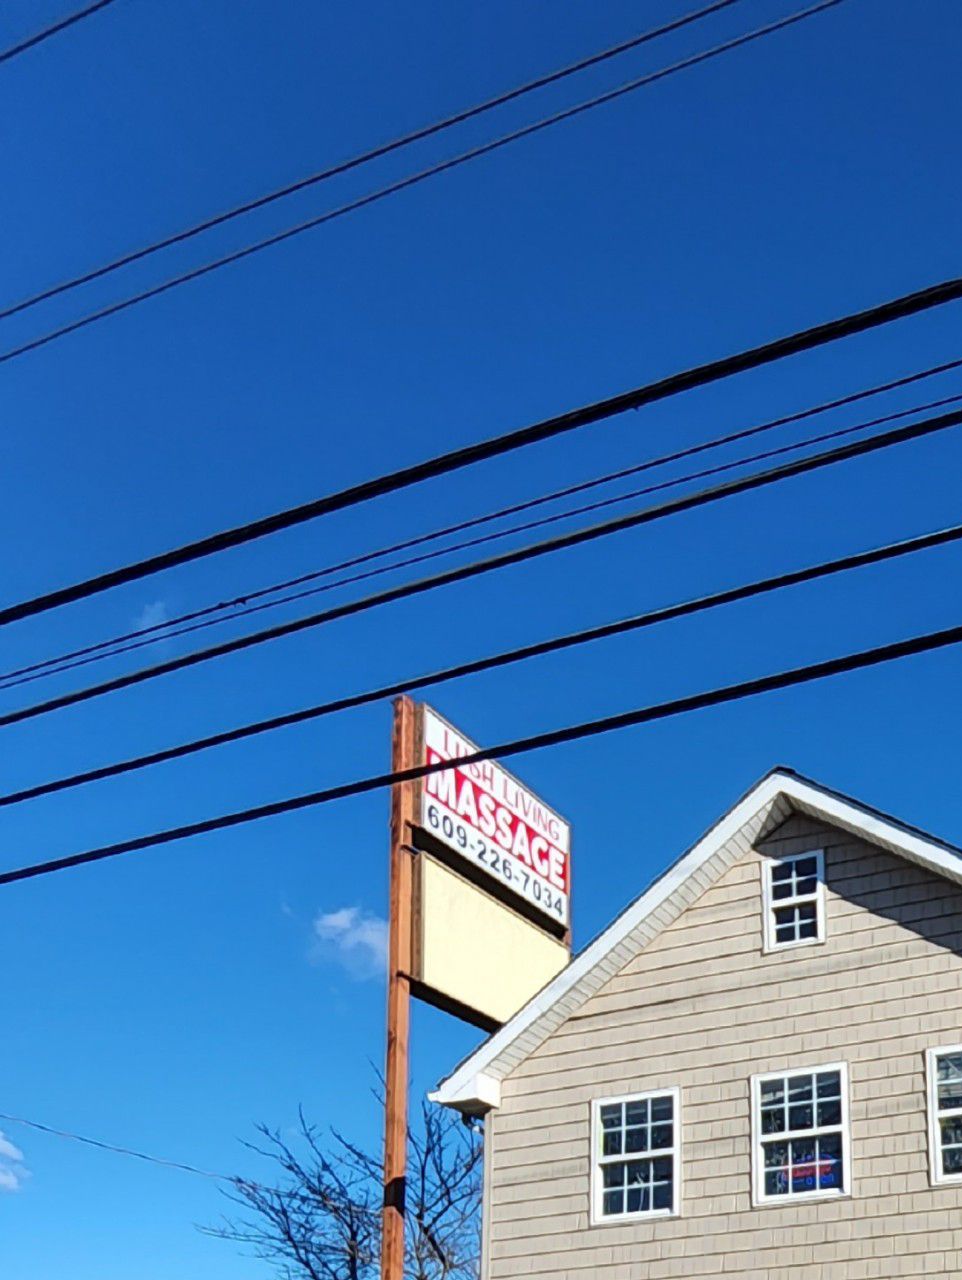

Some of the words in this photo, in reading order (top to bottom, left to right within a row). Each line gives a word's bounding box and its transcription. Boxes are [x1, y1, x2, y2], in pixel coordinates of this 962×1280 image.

[427, 753, 565, 890] MASSAGE
[427, 805, 563, 916] 609-226-7034
[502, 778, 560, 841] LIVING
